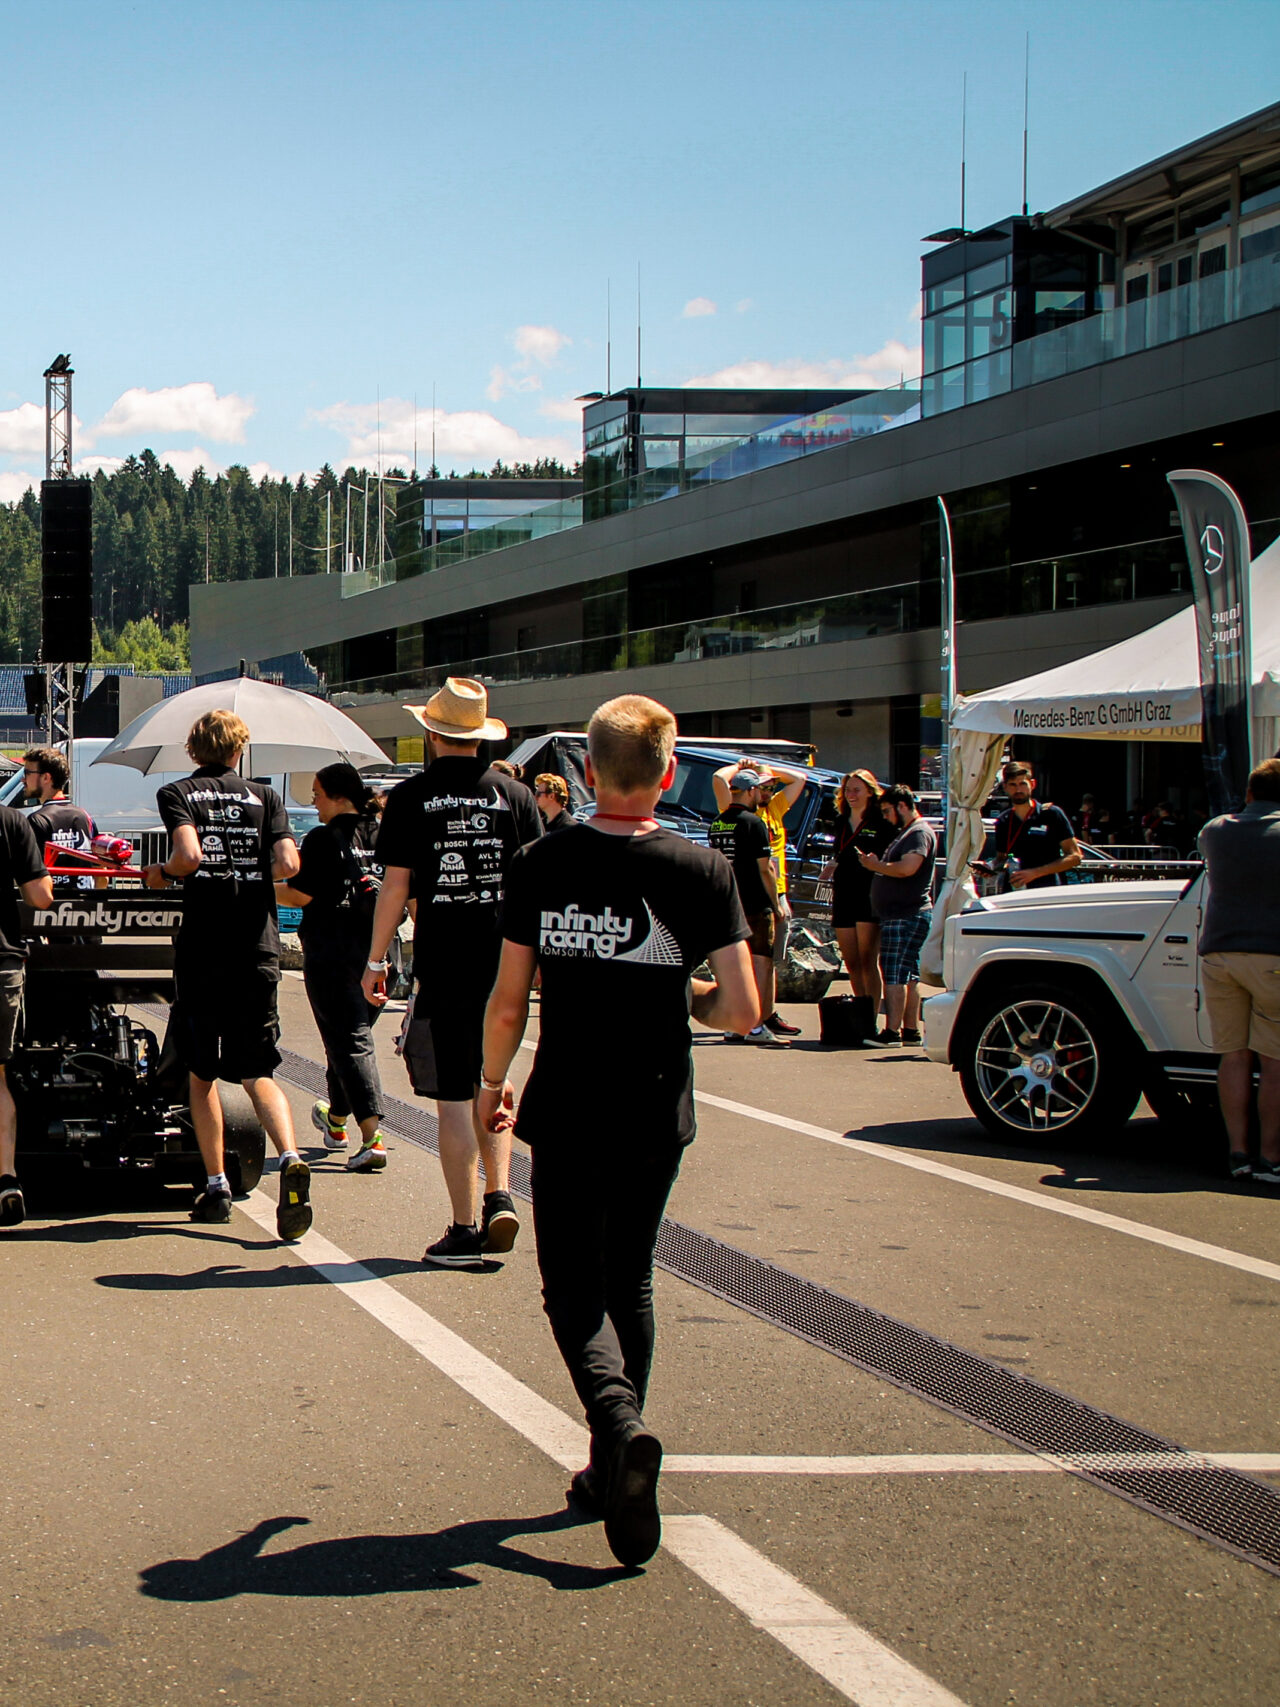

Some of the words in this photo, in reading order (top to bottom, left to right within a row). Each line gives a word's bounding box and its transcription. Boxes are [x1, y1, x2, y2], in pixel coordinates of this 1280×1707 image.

[991, 292, 1008, 346] 5
[1013, 705, 1095, 728] Mercedes-Benz
[1098, 704, 1107, 725] G
[1109, 701, 1142, 724] GmbH
[1145, 700, 1171, 721] Graz
[423, 794, 458, 810] infinity
[459, 797, 488, 808] racing
[201, 854, 227, 862] AIP
[202, 843, 224, 851] MAHA
[440, 860, 465, 871] MAHA
[437, 873, 469, 883] AIP
[33, 902, 122, 933] infinity
[125, 911, 184, 927] racin
[540, 903, 633, 943] infinity
[539, 929, 618, 959] racing
